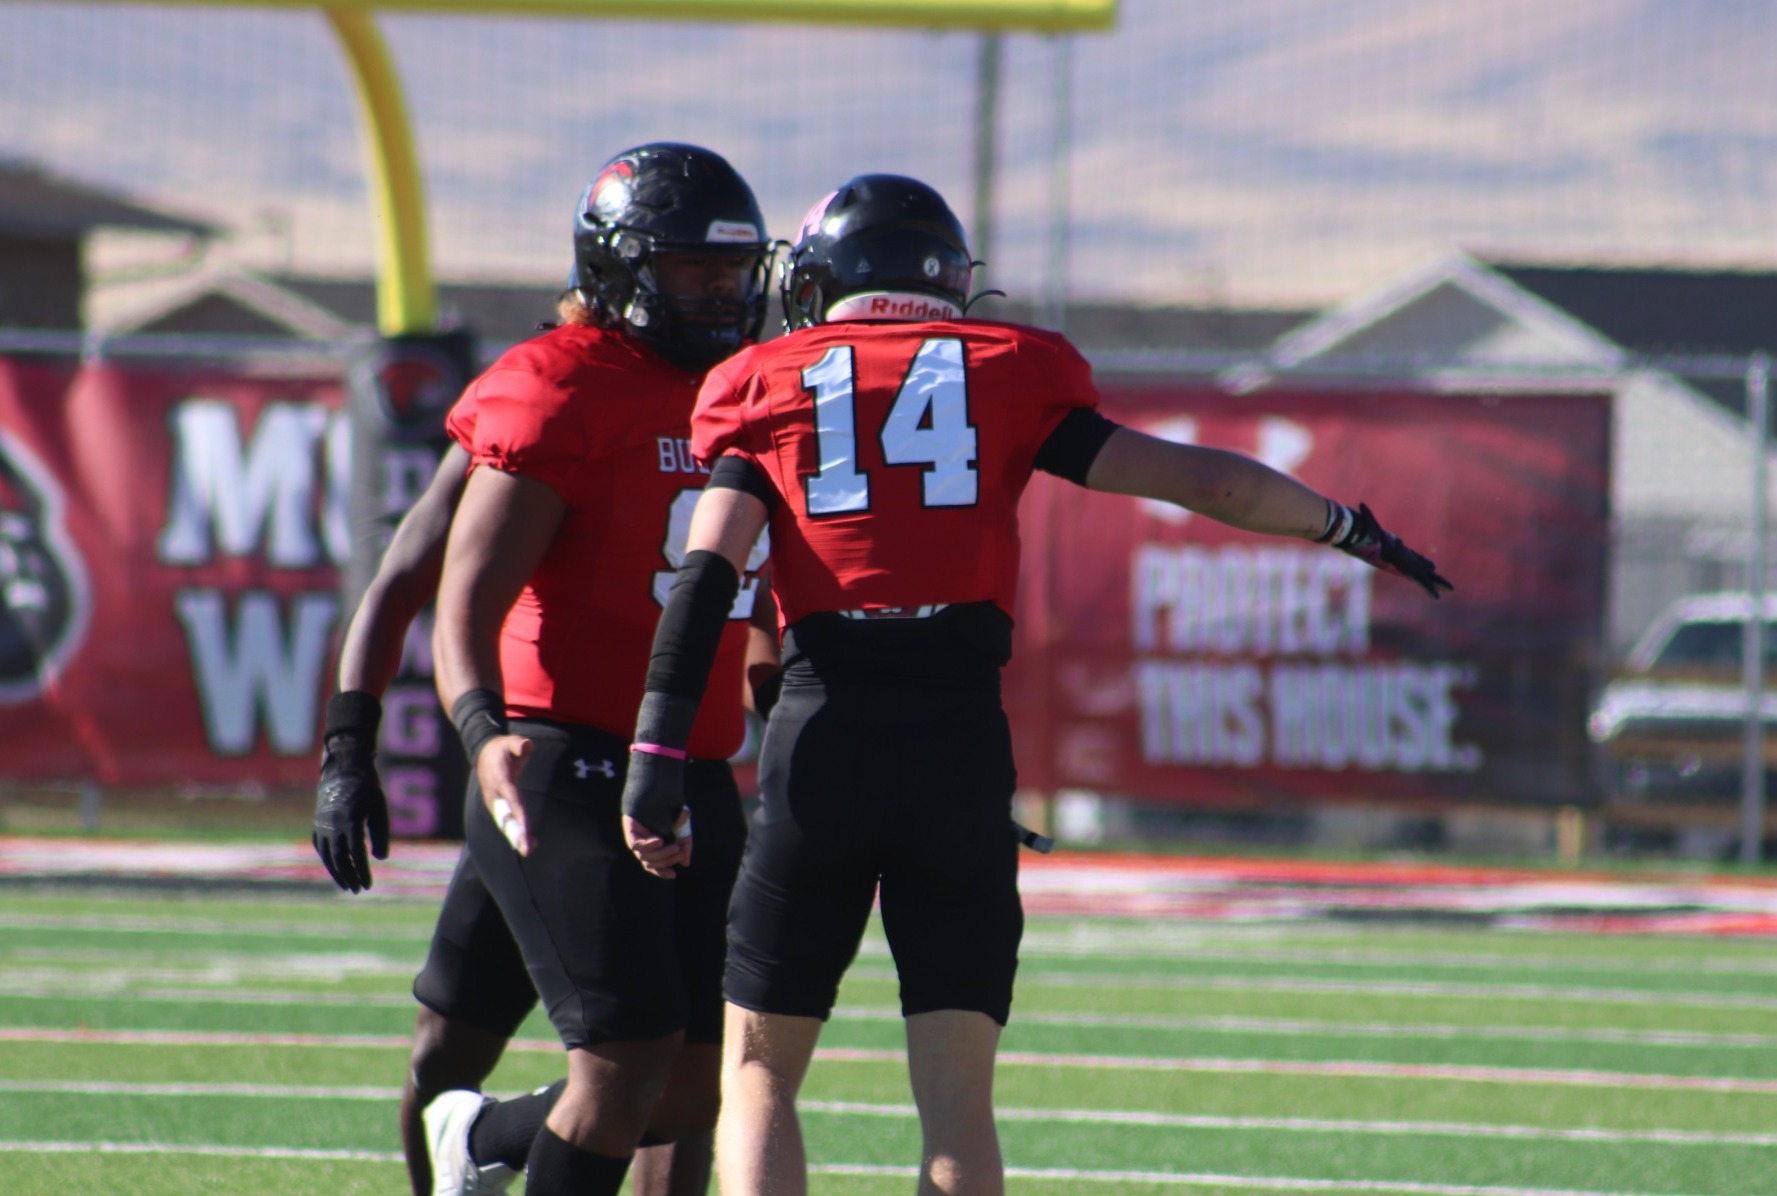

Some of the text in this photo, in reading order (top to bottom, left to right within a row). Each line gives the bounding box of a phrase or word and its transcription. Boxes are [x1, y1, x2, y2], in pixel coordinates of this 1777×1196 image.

[871, 297, 954, 321] Riddell
[657, 438, 711, 474] BU
[799, 338, 979, 515] 14
[1132, 544, 1373, 654] PROTECT
[1137, 661, 1265, 768] THIS
